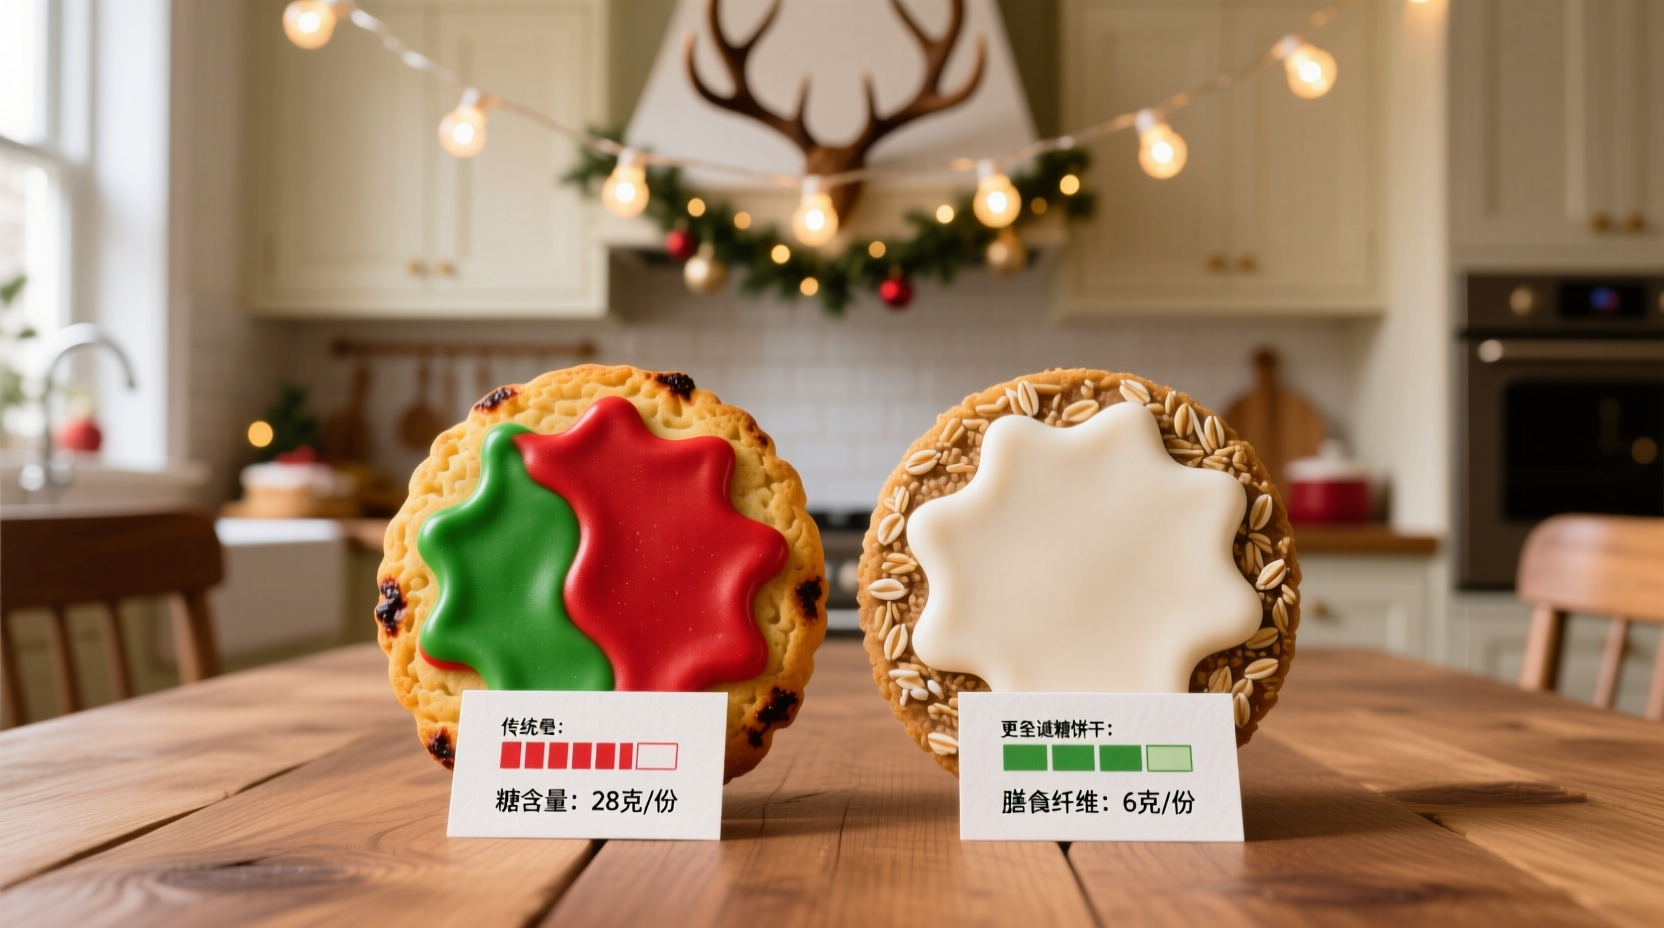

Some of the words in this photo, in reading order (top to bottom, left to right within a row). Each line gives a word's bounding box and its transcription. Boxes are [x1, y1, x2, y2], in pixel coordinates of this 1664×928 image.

[495, 787, 678, 816] 糖含量：28克/份
[1001, 788, 1196, 816] 膳食纤维：6克/份
